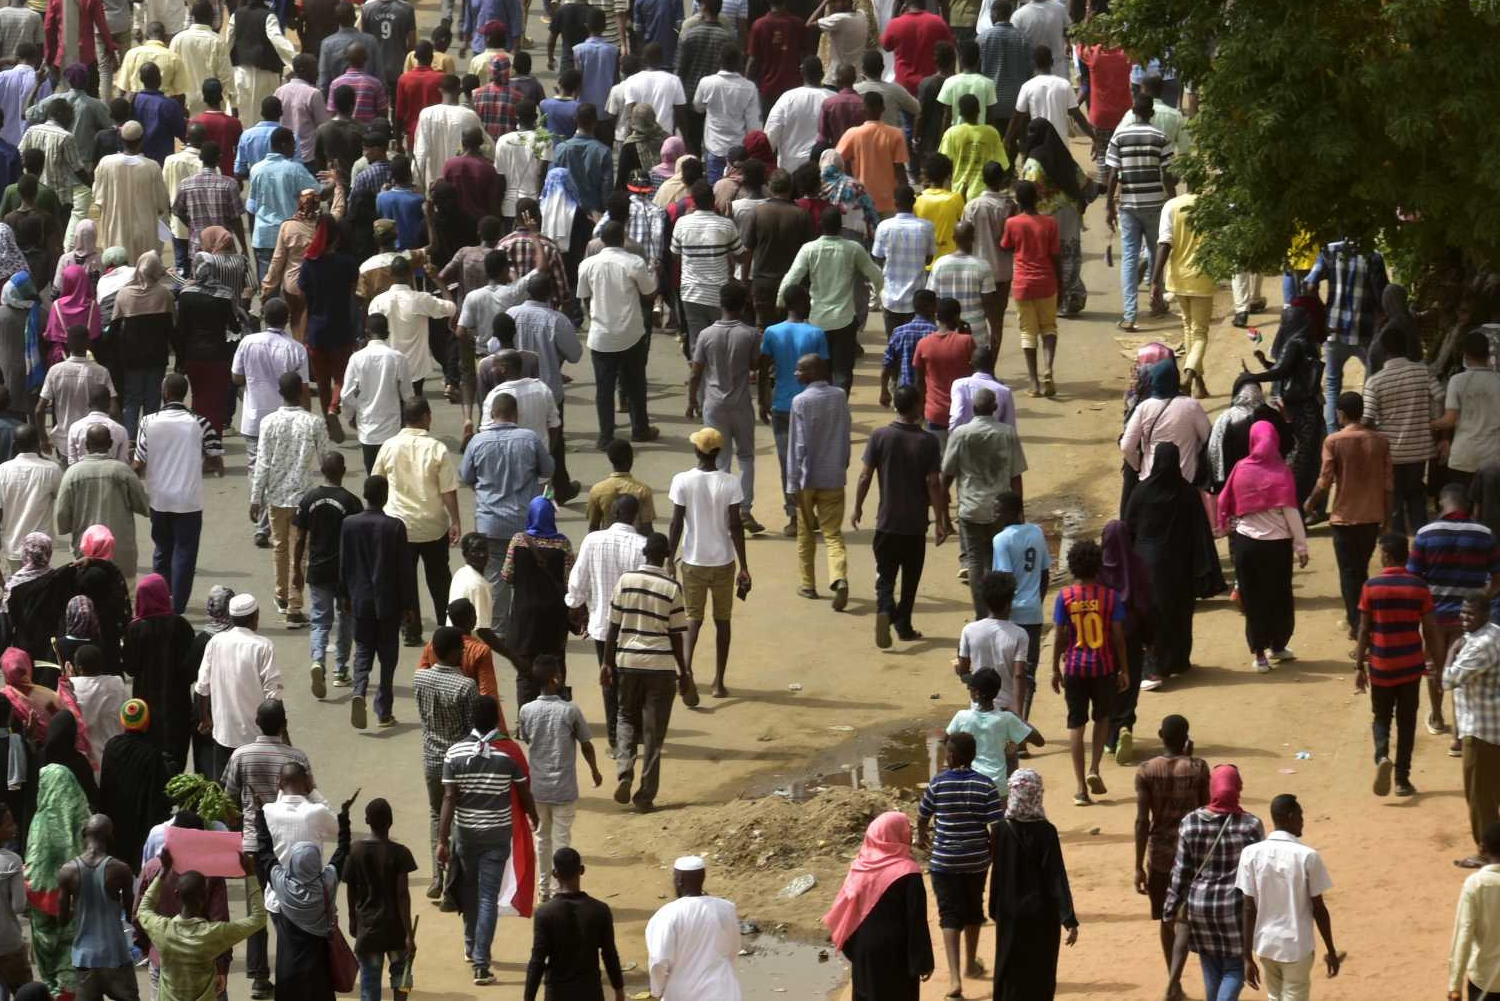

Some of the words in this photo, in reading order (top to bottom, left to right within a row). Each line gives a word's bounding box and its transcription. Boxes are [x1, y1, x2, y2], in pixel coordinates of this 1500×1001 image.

[381, 20, 392, 40] 9
[1024, 547, 1037, 572] 9
[1071, 612, 1104, 649] 10
